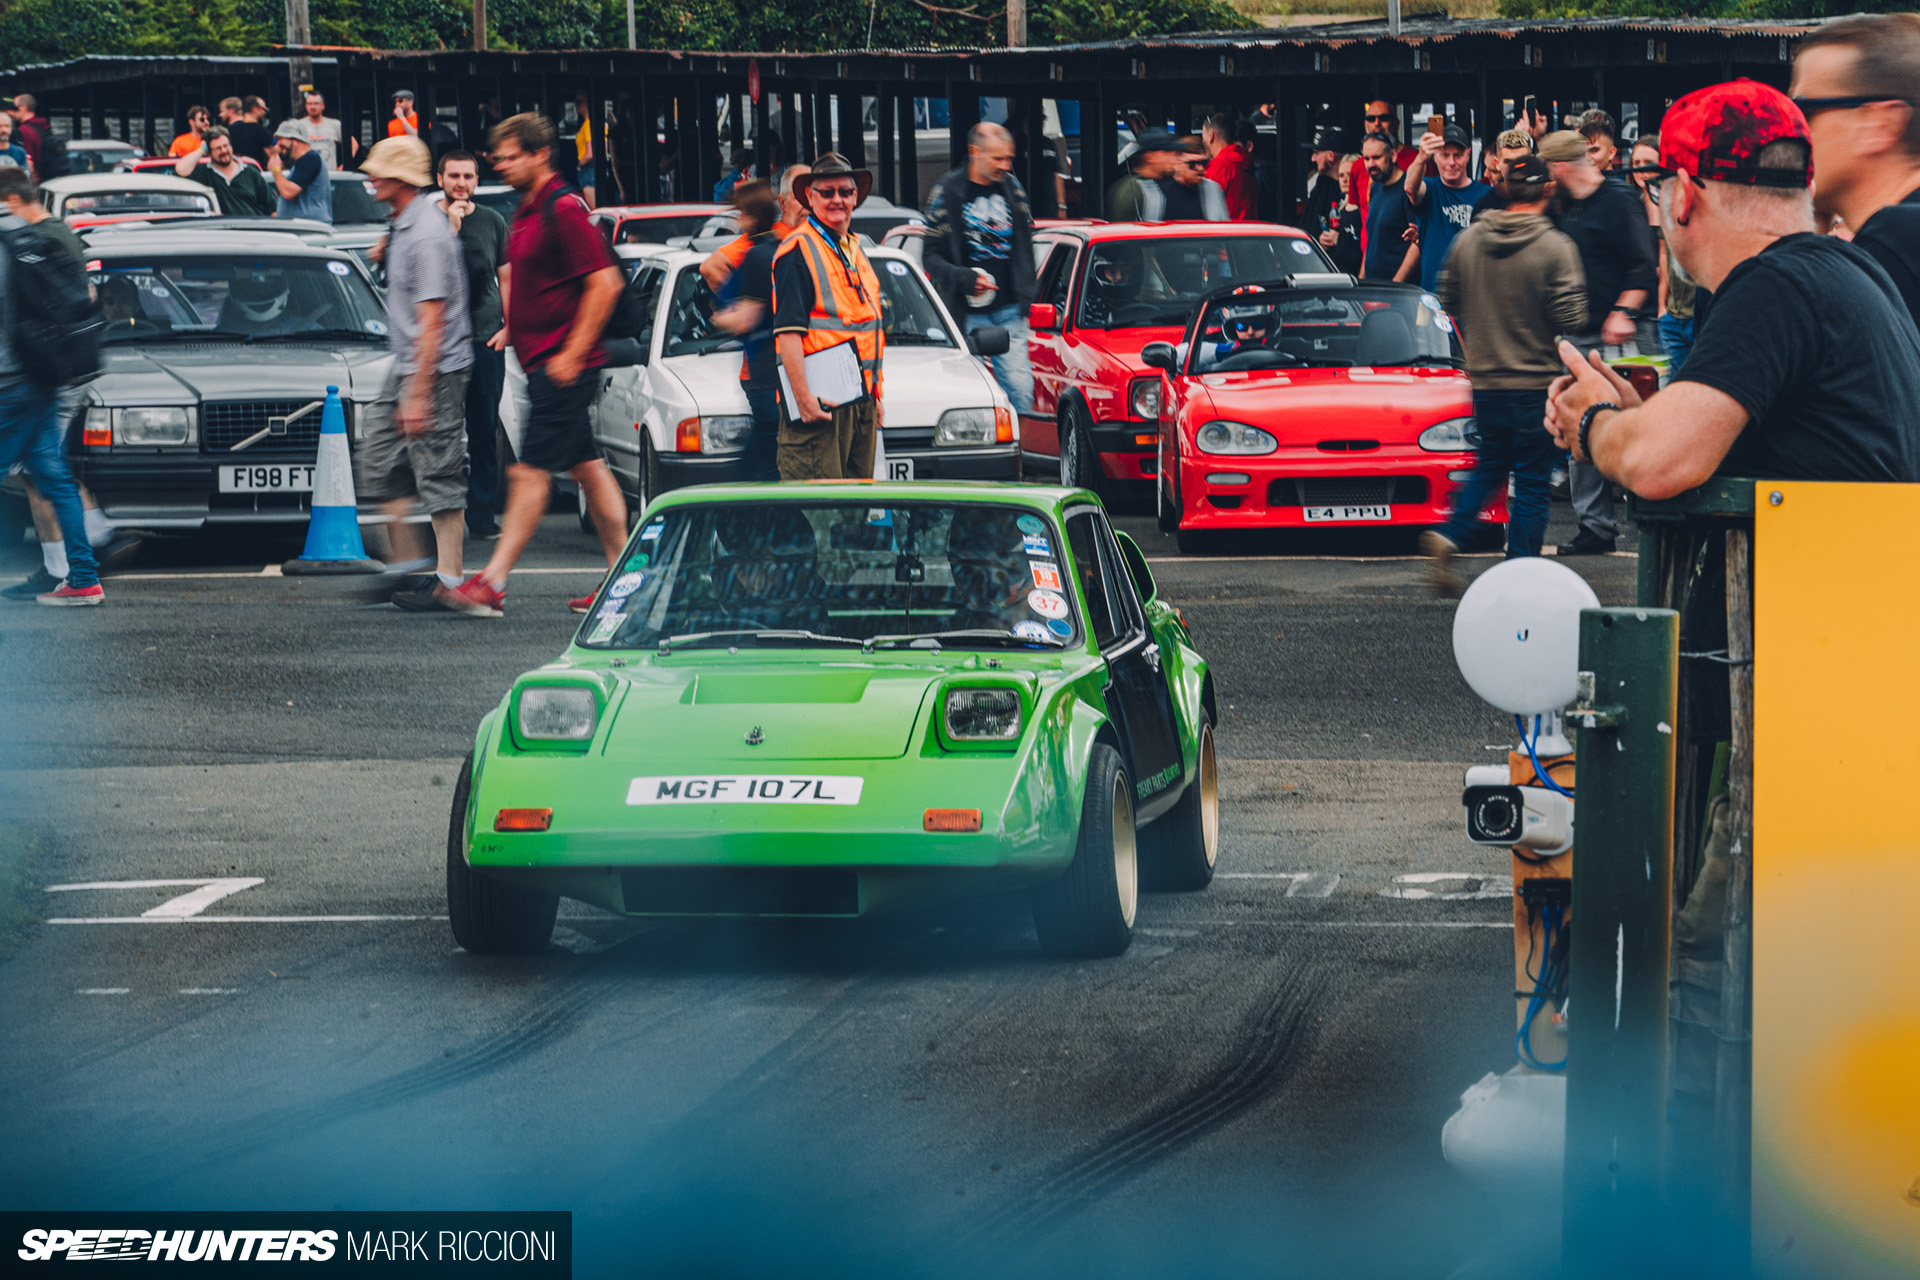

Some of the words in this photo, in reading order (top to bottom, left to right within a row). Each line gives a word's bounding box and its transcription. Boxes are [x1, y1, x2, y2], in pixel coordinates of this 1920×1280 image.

[234, 468, 282, 488] F198
[1307, 507, 1334, 519] E4
[1344, 507, 1387, 518] PPU
[1036, 596, 1060, 612] 37
[656, 780, 737, 799] MGF
[747, 780, 836, 800] 107L
